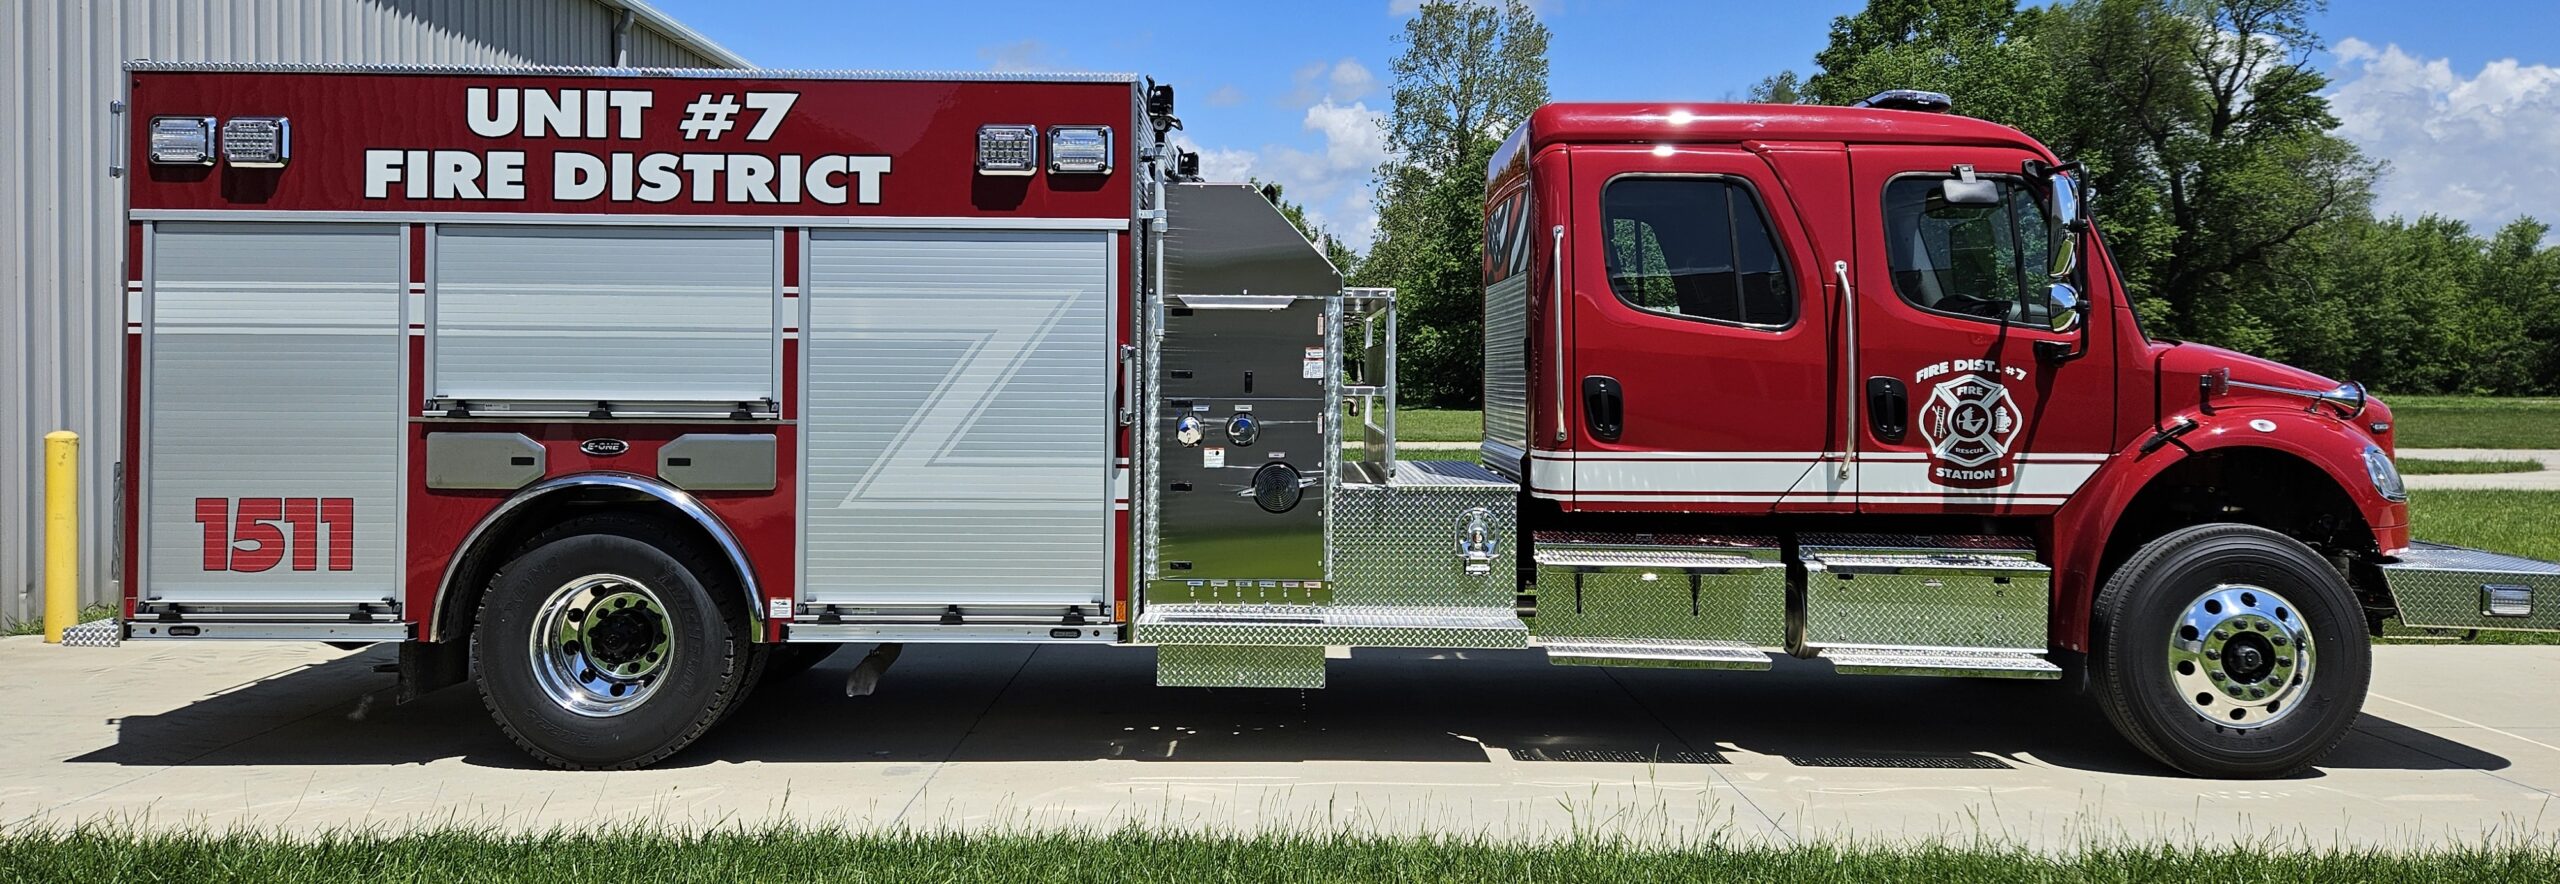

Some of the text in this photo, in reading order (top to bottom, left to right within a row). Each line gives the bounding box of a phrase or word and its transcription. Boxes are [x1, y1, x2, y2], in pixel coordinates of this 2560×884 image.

[466, 86, 800, 142] UNIT #7
[364, 148, 892, 205] FIRE DISTRICT
[1916, 359, 2027, 383] FIRE DIST. #7
[1956, 385, 1984, 397] FIRE
[587, 442, 620, 451] E-ONE
[1935, 467, 2008, 480] STATION 1
[195, 497, 354, 572] 1511
